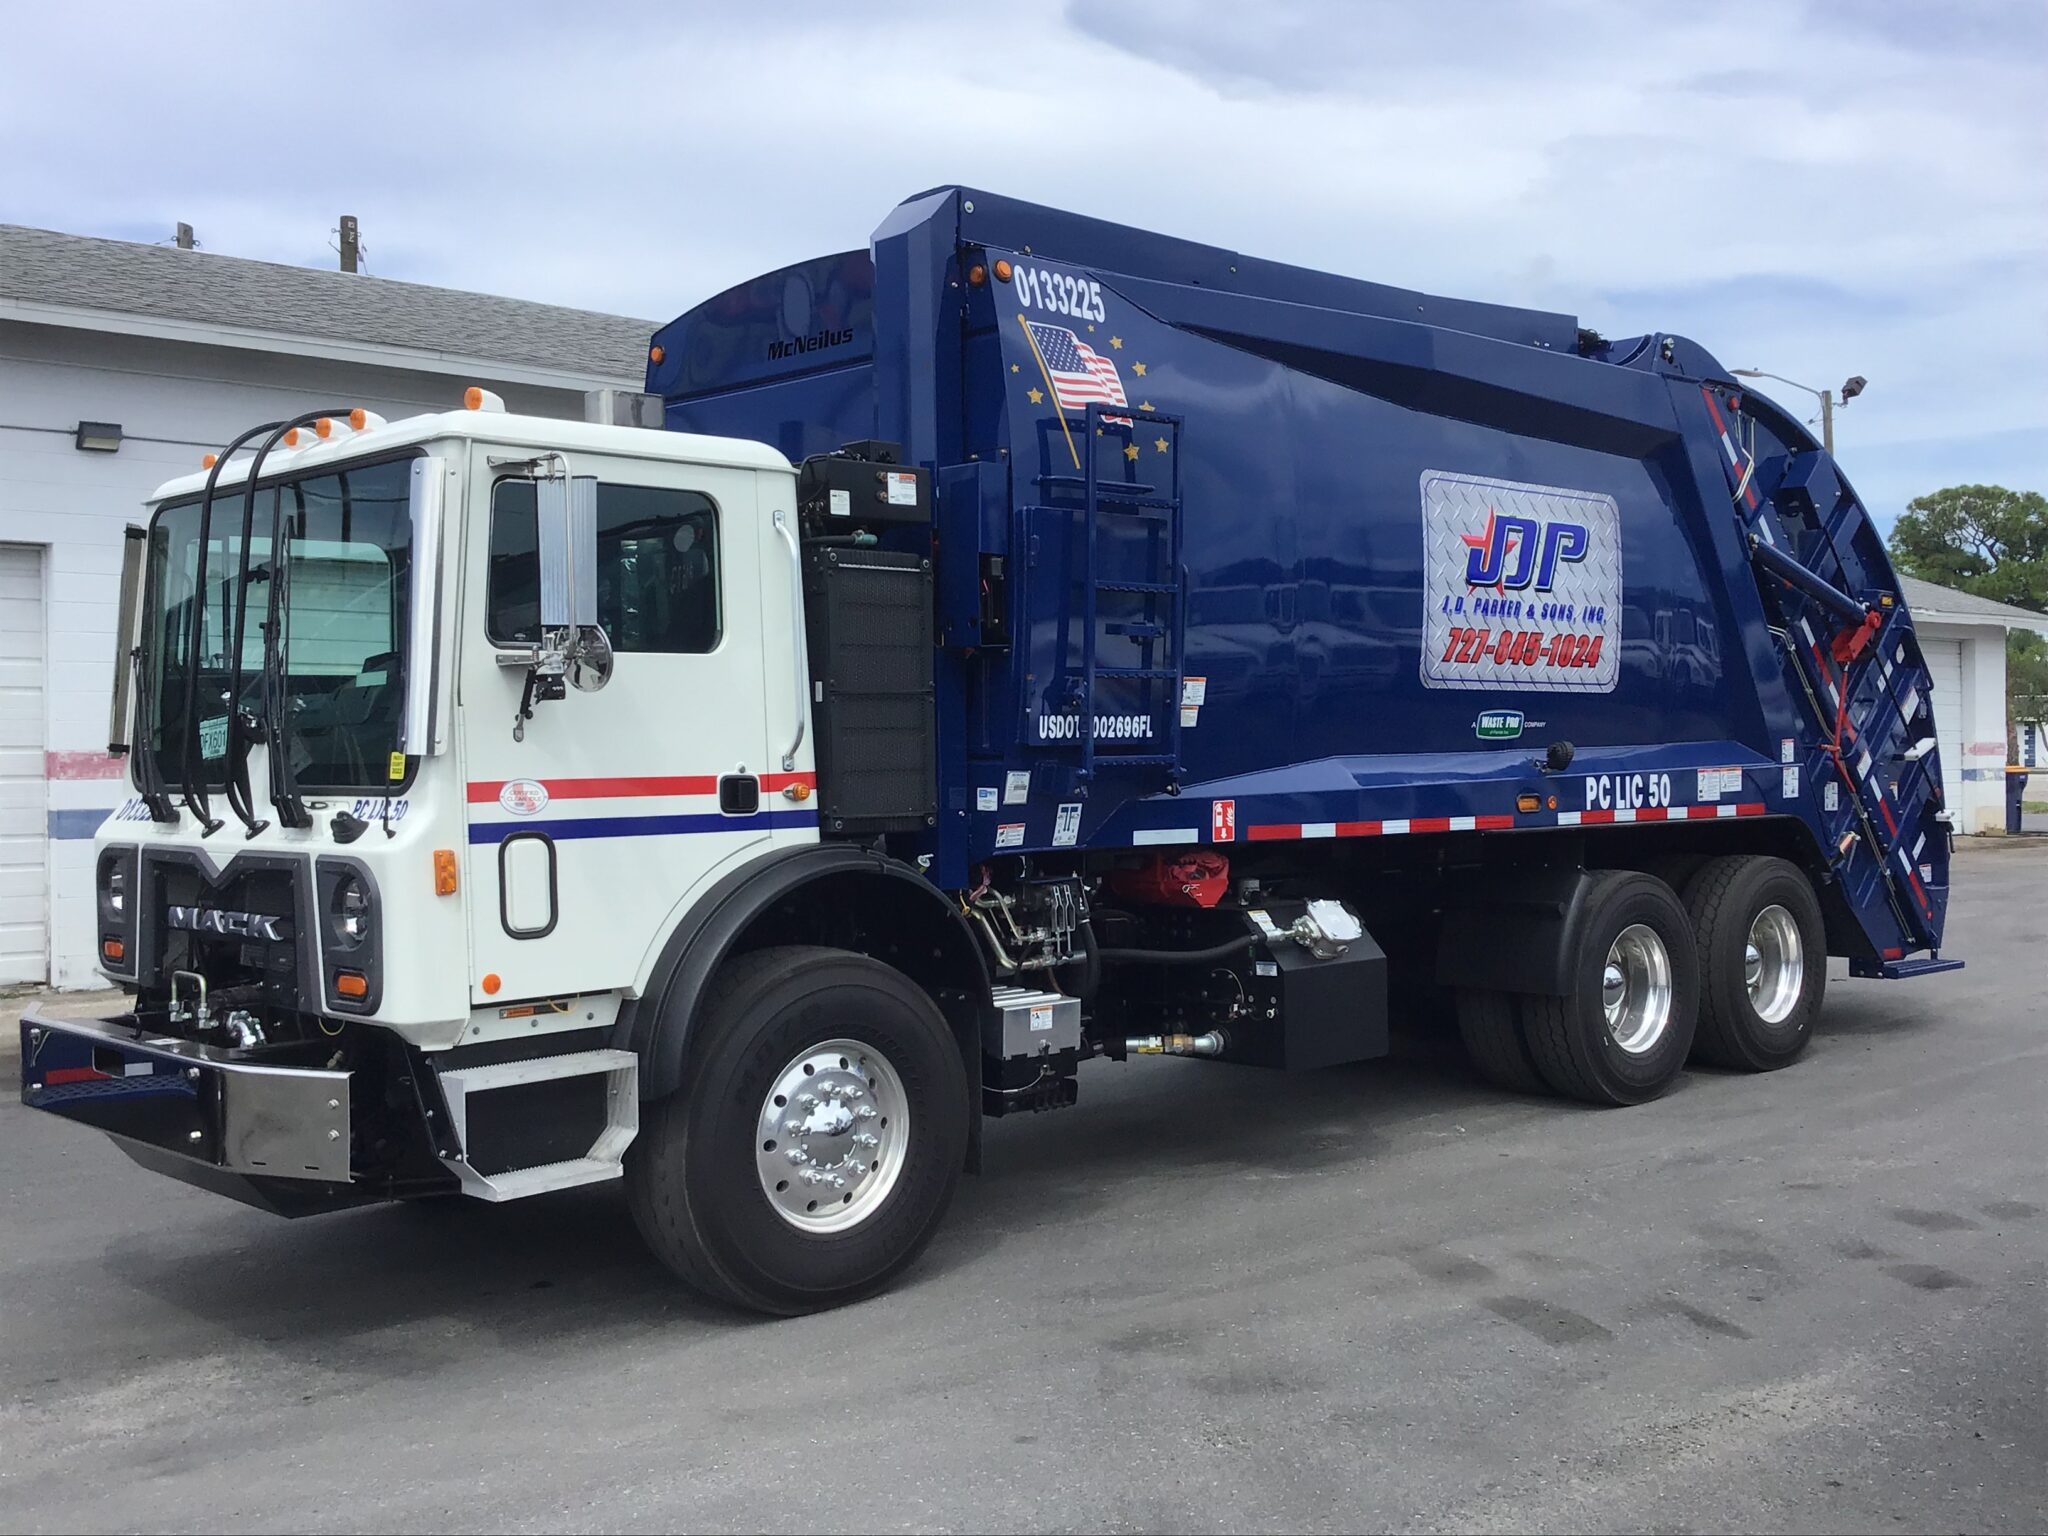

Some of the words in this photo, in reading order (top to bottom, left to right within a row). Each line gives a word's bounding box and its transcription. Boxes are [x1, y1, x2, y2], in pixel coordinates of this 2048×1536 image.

[1014, 265, 1105, 323] 0133225
[767, 328, 854, 361] McNeilus
[1442, 596, 1467, 615] J.D.
[1473, 597, 1522, 618] PARKER
[1526, 603, 1535, 620] &
[1541, 603, 1577, 624] SONS,
[1442, 627, 1604, 668] 727-845-1024
[1481, 716, 1504, 728] WASTE
[1505, 716, 1520, 728] PRO
[1585, 774, 1611, 810] PC
[1616, 774, 1643, 809] LIC
[1649, 773, 1671, 807] 50
[168, 906, 284, 940] MACK
